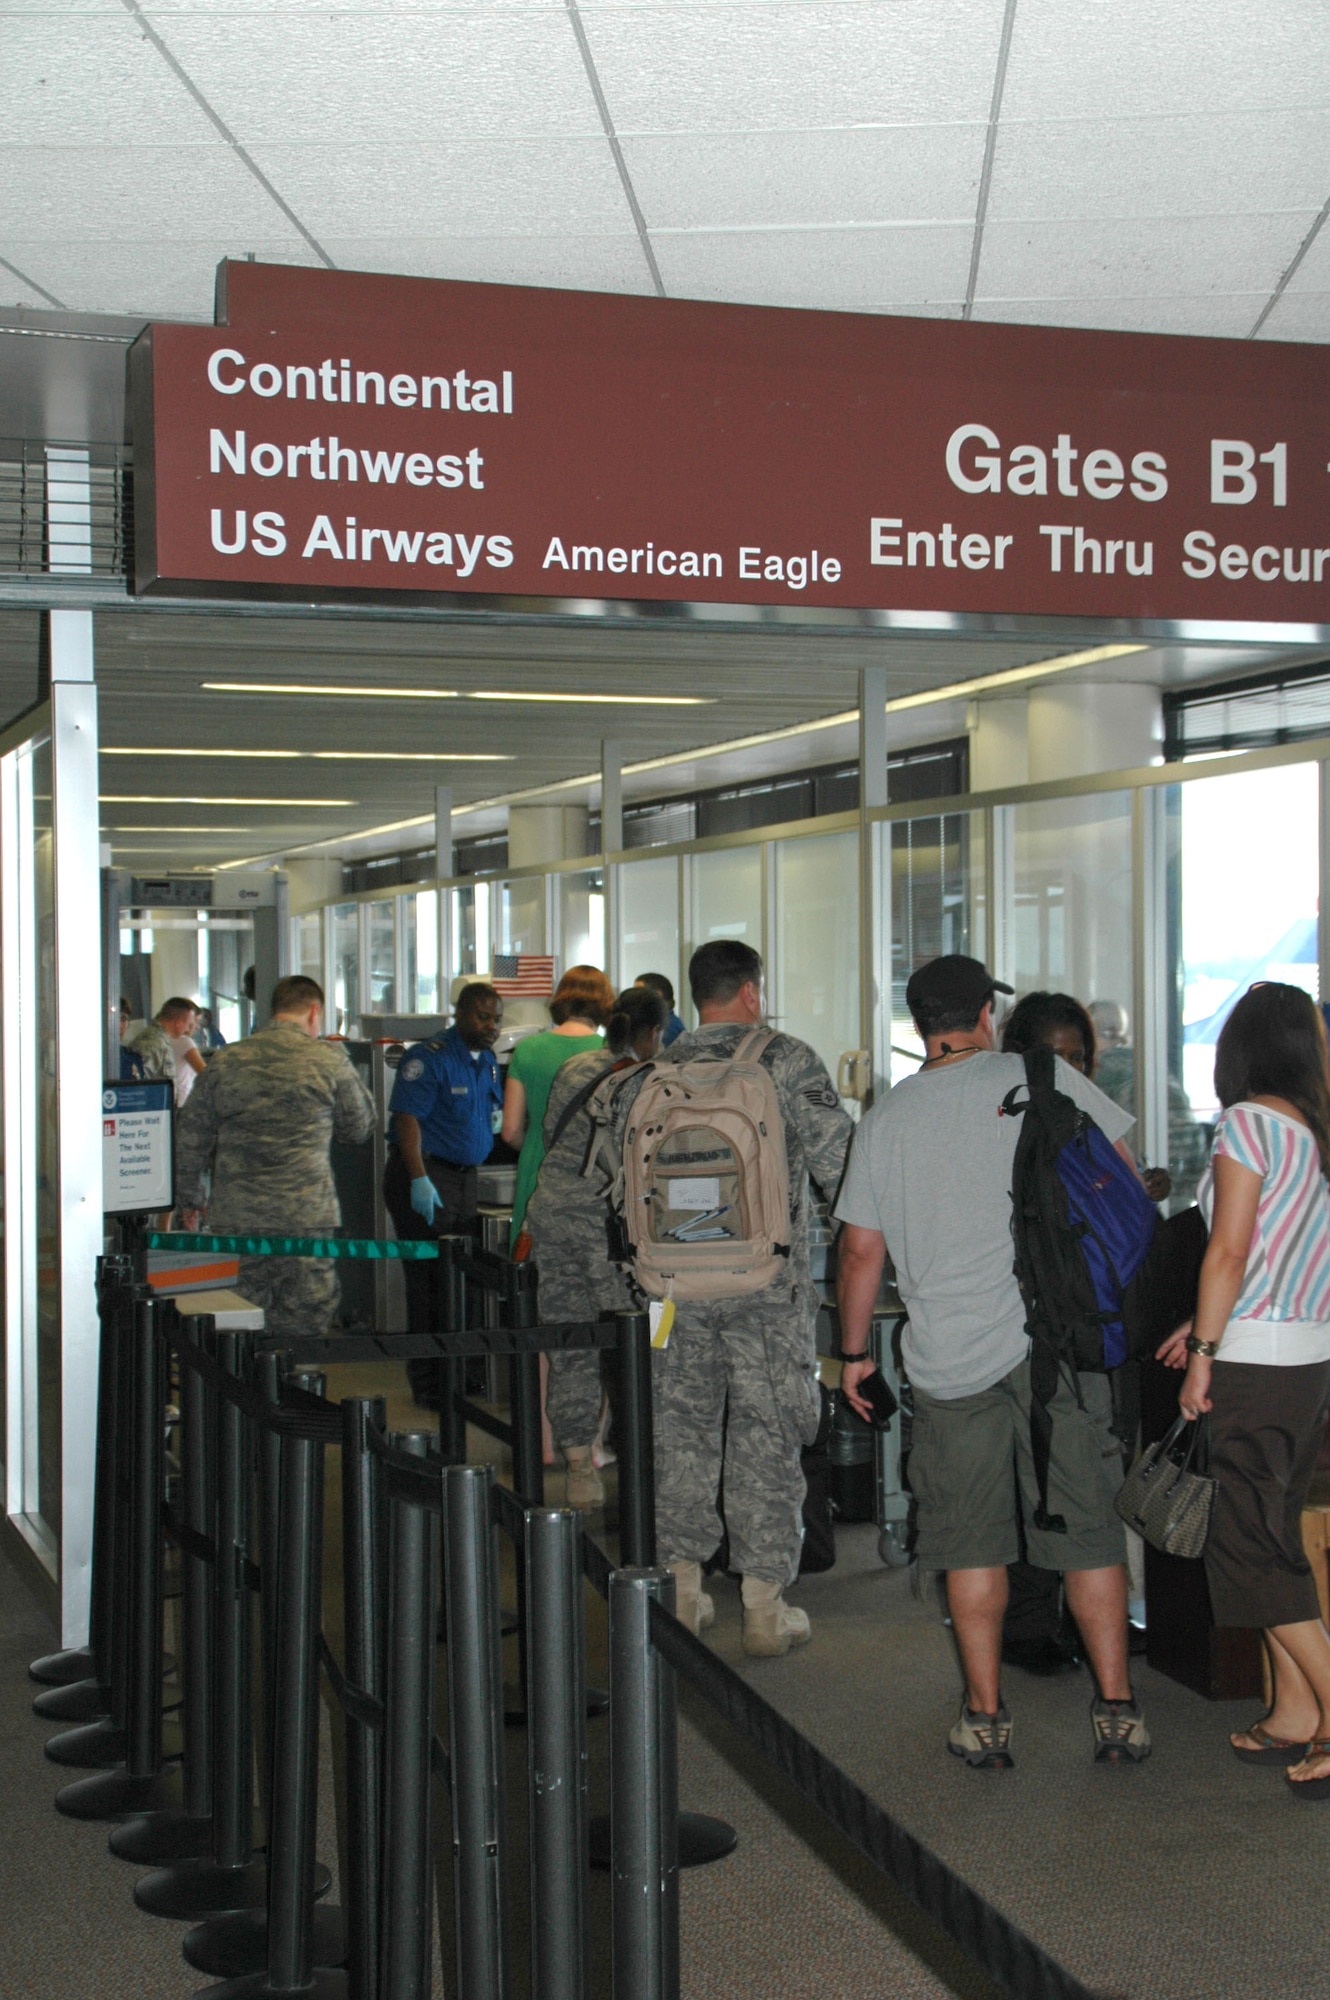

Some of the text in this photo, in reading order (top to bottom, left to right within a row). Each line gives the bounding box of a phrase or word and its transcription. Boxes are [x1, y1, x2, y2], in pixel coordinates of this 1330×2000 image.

[207, 348, 513, 414] Continental
[209, 428, 485, 490] Northwest
[945, 423, 1287, 506] Gates B1
[210, 508, 514, 578] US Airways
[542, 536, 842, 590] American Eagle
[870, 517, 1013, 570] Enter
[1039, 525, 1153, 576] Thru
[119, 1117, 160, 1127] Please Wait
[119, 1130, 149, 1140] Here For
[119, 1142, 151, 1152] The Next
[119, 1155, 151, 1165] Available
